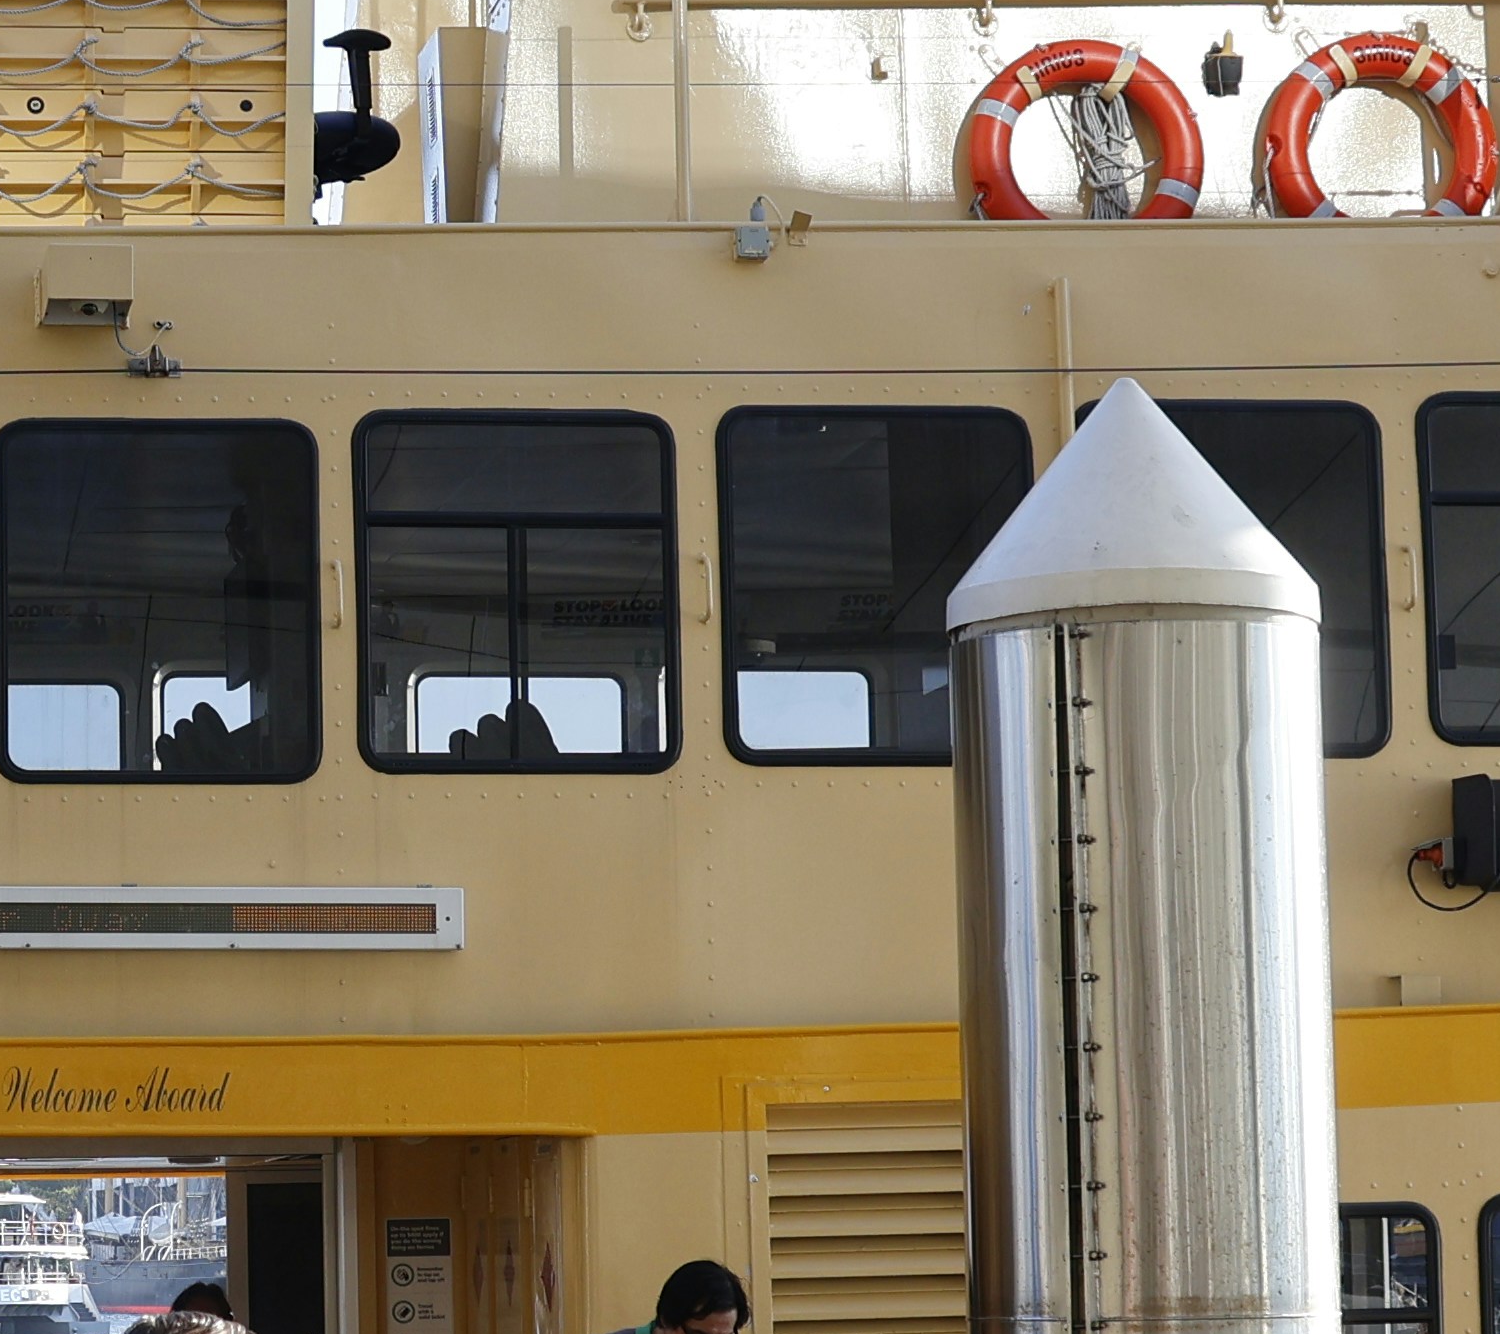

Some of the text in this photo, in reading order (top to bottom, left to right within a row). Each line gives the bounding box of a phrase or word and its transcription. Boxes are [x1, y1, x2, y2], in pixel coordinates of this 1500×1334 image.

[53, 904, 148, 932] Quay
[2, 1065, 231, 1113] Welcome Aboard
